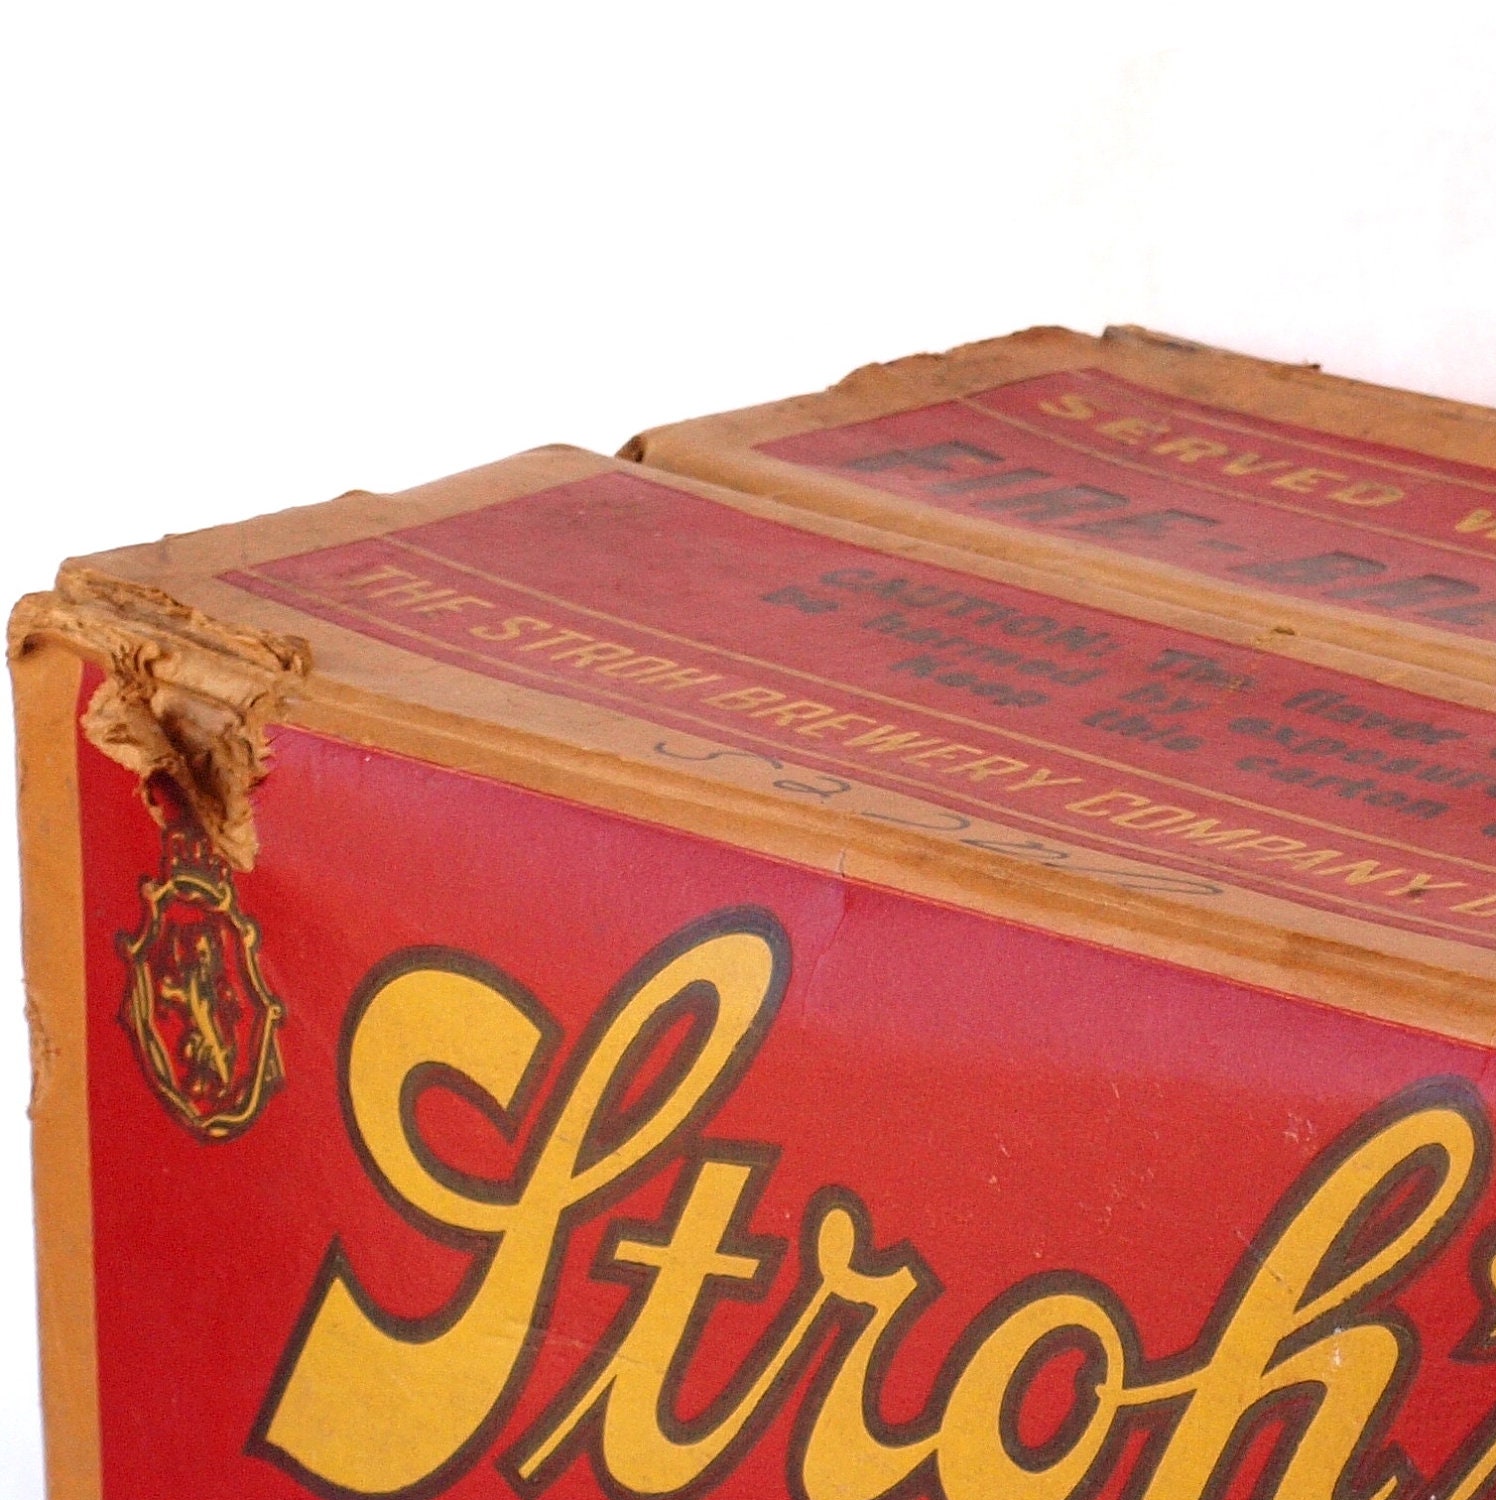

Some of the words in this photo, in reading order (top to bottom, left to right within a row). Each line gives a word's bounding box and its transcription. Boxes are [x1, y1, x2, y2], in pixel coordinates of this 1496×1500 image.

[1038, 394, 1404, 508] SERVED
[349, 563, 485, 618] THE
[470, 613, 720, 690] STROH
[704, 685, 1086, 792] BREWERY
[760, 586, 842, 615] be
[862, 611, 1107, 687] harmed
[1120, 682, 1210, 715] by
[1147, 649, 1258, 693] The
[1283, 688, 1468, 745] flavor
[890, 653, 1050, 709] Keep
[1081, 707, 1204, 752] this
[1234, 754, 1451, 819] carton
